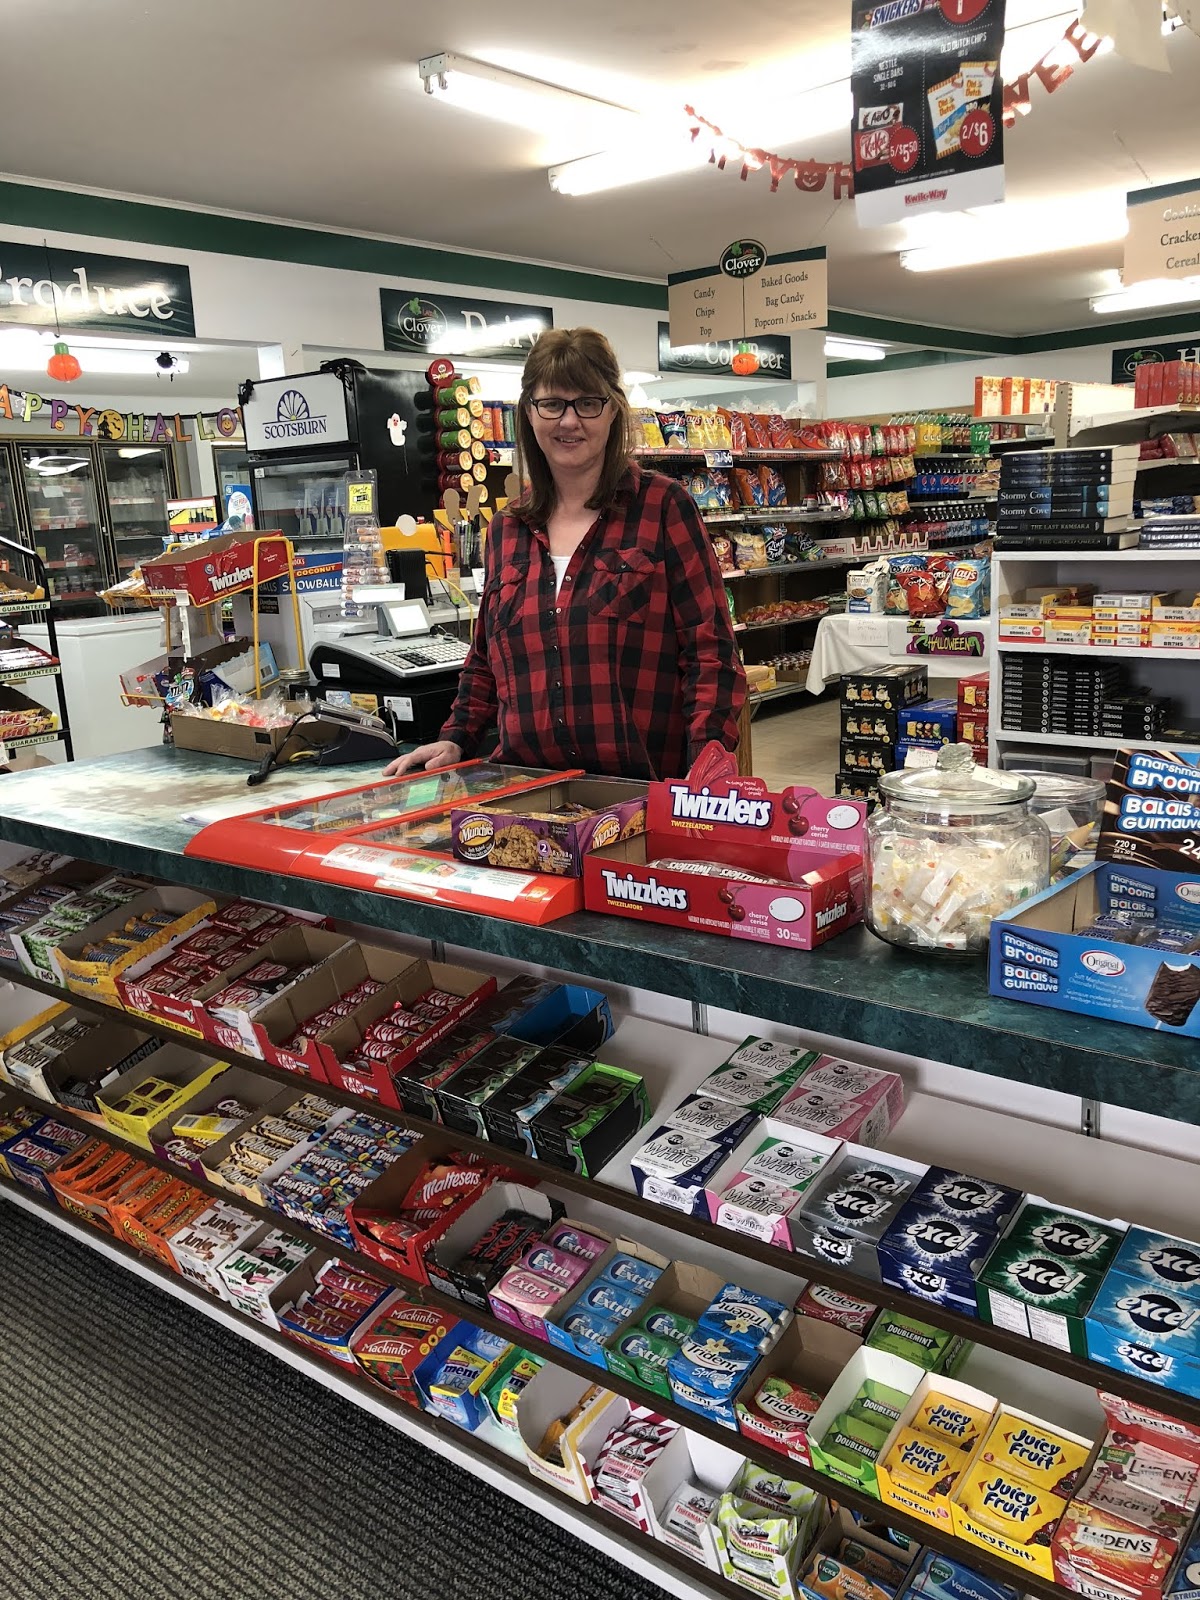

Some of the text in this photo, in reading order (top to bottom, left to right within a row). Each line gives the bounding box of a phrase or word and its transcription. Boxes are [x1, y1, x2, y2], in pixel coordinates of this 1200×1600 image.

[872, 0, 920, 26] SNICKERS
[970, 32, 987, 46] CHIPS
[962, 123, 988, 147] 2/$6
[905, 189, 948, 205] Kwik-Way
[725, 257, 761, 272] Clover
[732, 266, 755, 276] FARM
[761, 271, 808, 288] Baked Goods
[0, 266, 174, 320] roduce
[694, 288, 716, 300] Candy
[765, 292, 804, 308] Bag Candy
[403, 316, 443, 334] Clover
[695, 307, 715, 320] Chips
[754, 315, 784, 328] Popcorn
[791, 310, 817, 323] Snacks
[700, 326, 712, 338] Pop
[126, 406, 244, 443] HALLO
[264, 418, 327, 440] SCOTSBURN
[1000, 490, 1050, 502] Stormy Cove
[1000, 506, 1050, 517] Stormy Cove
[296, 565, 336, 577] COCONUT
[282, 577, 343, 592] SOWBALLS
[2, 603, 47, 613] GUARANTEED
[928, 636, 970, 652] HALLOWEEN
[13, 667, 58, 679] GUARANTEED
[10, 735, 55, 748] GUARANTEED
[1135, 756, 1200, 778] marshma
[670, 785, 773, 828] Twizzlers
[460, 822, 495, 844] Munchies
[671, 820, 714, 831] TWIZZELATORS
[810, 825, 830, 834] cherry
[541, 843, 547, 853] 2
[1115, 839, 1130, 848] 720
[601, 870, 688, 910] Twizzlers
[1111, 882, 1155, 899] Brooms
[607, 899, 643, 911] TWIZZELATORS
[748, 911, 769, 921] cherry
[815, 901, 848, 929] Twizzlers
[750, 918, 768, 927] cerise
[776, 927, 790, 940] 30
[1005, 945, 1059, 968] Brooms
[1086, 954, 1119, 971] Original
[40, 1122, 84, 1145] CRUNCH
[13, 1141, 58, 1165] CRUNCH
[422, 1171, 480, 1203] Maltesers
[848, 1171, 911, 1197] excel
[933, 1180, 1005, 1209] excel
[826, 1191, 894, 1219] excel
[556, 1235, 596, 1260] Extra
[813, 1236, 852, 1258] excel
[905, 1221, 980, 1252] excel
[1031, 1224, 1110, 1254] excel
[533, 1251, 571, 1278] Extra
[617, 1260, 655, 1290] Extra
[1006, 1259, 1088, 1293] excel
[508, 1275, 550, 1299] Extra
[903, 1267, 947, 1291] excel
[598, 1288, 633, 1317] Extra
[813, 1287, 867, 1312] Trident
[823, 1308, 866, 1327] Splash
[1116, 1294, 1200, 1331] excel
[571, 1316, 607, 1345] Extra
[887, 1324, 934, 1348] DOUBLEMINT
[626, 1337, 669, 1368] Extra
[685, 1341, 739, 1372] Trident
[1117, 1343, 1174, 1372] excel
[670, 1380, 711, 1406] Trident
[760, 1394, 815, 1423] Trident
[931, 1404, 972, 1426] Juicy
[739, 1411, 785, 1440] Trident
[928, 1415, 966, 1438] Fruit
[1123, 1410, 1184, 1435] LUDEN'S
[904, 1440, 946, 1463] Juicy
[1012, 1428, 1062, 1456] Juicy
[901, 1452, 941, 1477] Fruit
[1008, 1442, 1054, 1471] Fruit
[987, 1476, 1038, 1506] Juicy
[890, 1491, 939, 1518] Juicy Fruit
[983, 1491, 1030, 1522] Fruit
[963, 1522, 1032, 1562] Juicy Fruit
[841, 1572, 867, 1590] Vitamin
[930, 1566, 949, 1579] VICKS
[838, 1578, 867, 1598] Vitamine
